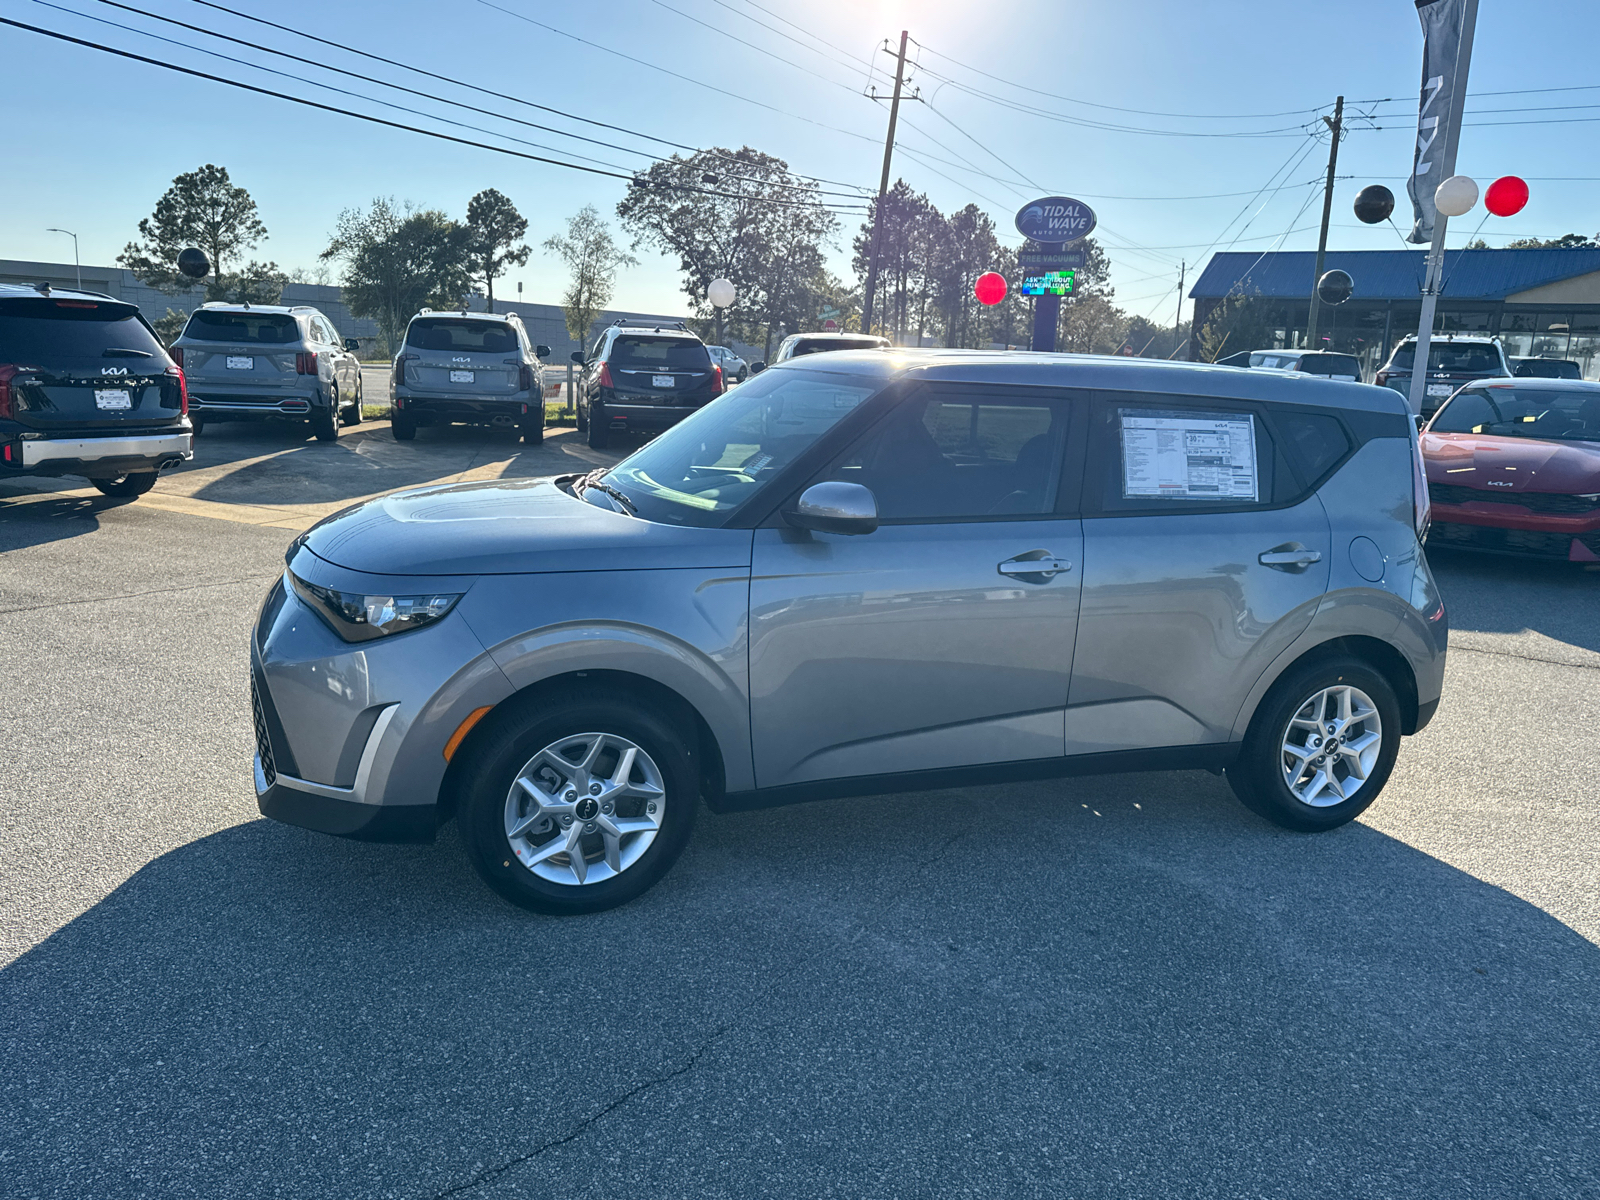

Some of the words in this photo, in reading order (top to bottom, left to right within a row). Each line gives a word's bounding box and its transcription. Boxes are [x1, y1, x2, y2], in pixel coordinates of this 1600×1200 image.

[1043, 206, 1080, 217] TIDAL
[1048, 218, 1087, 229] WAVE
[1043, 255, 1080, 263] VACUUMS
[101, 367, 127, 375] KIA
